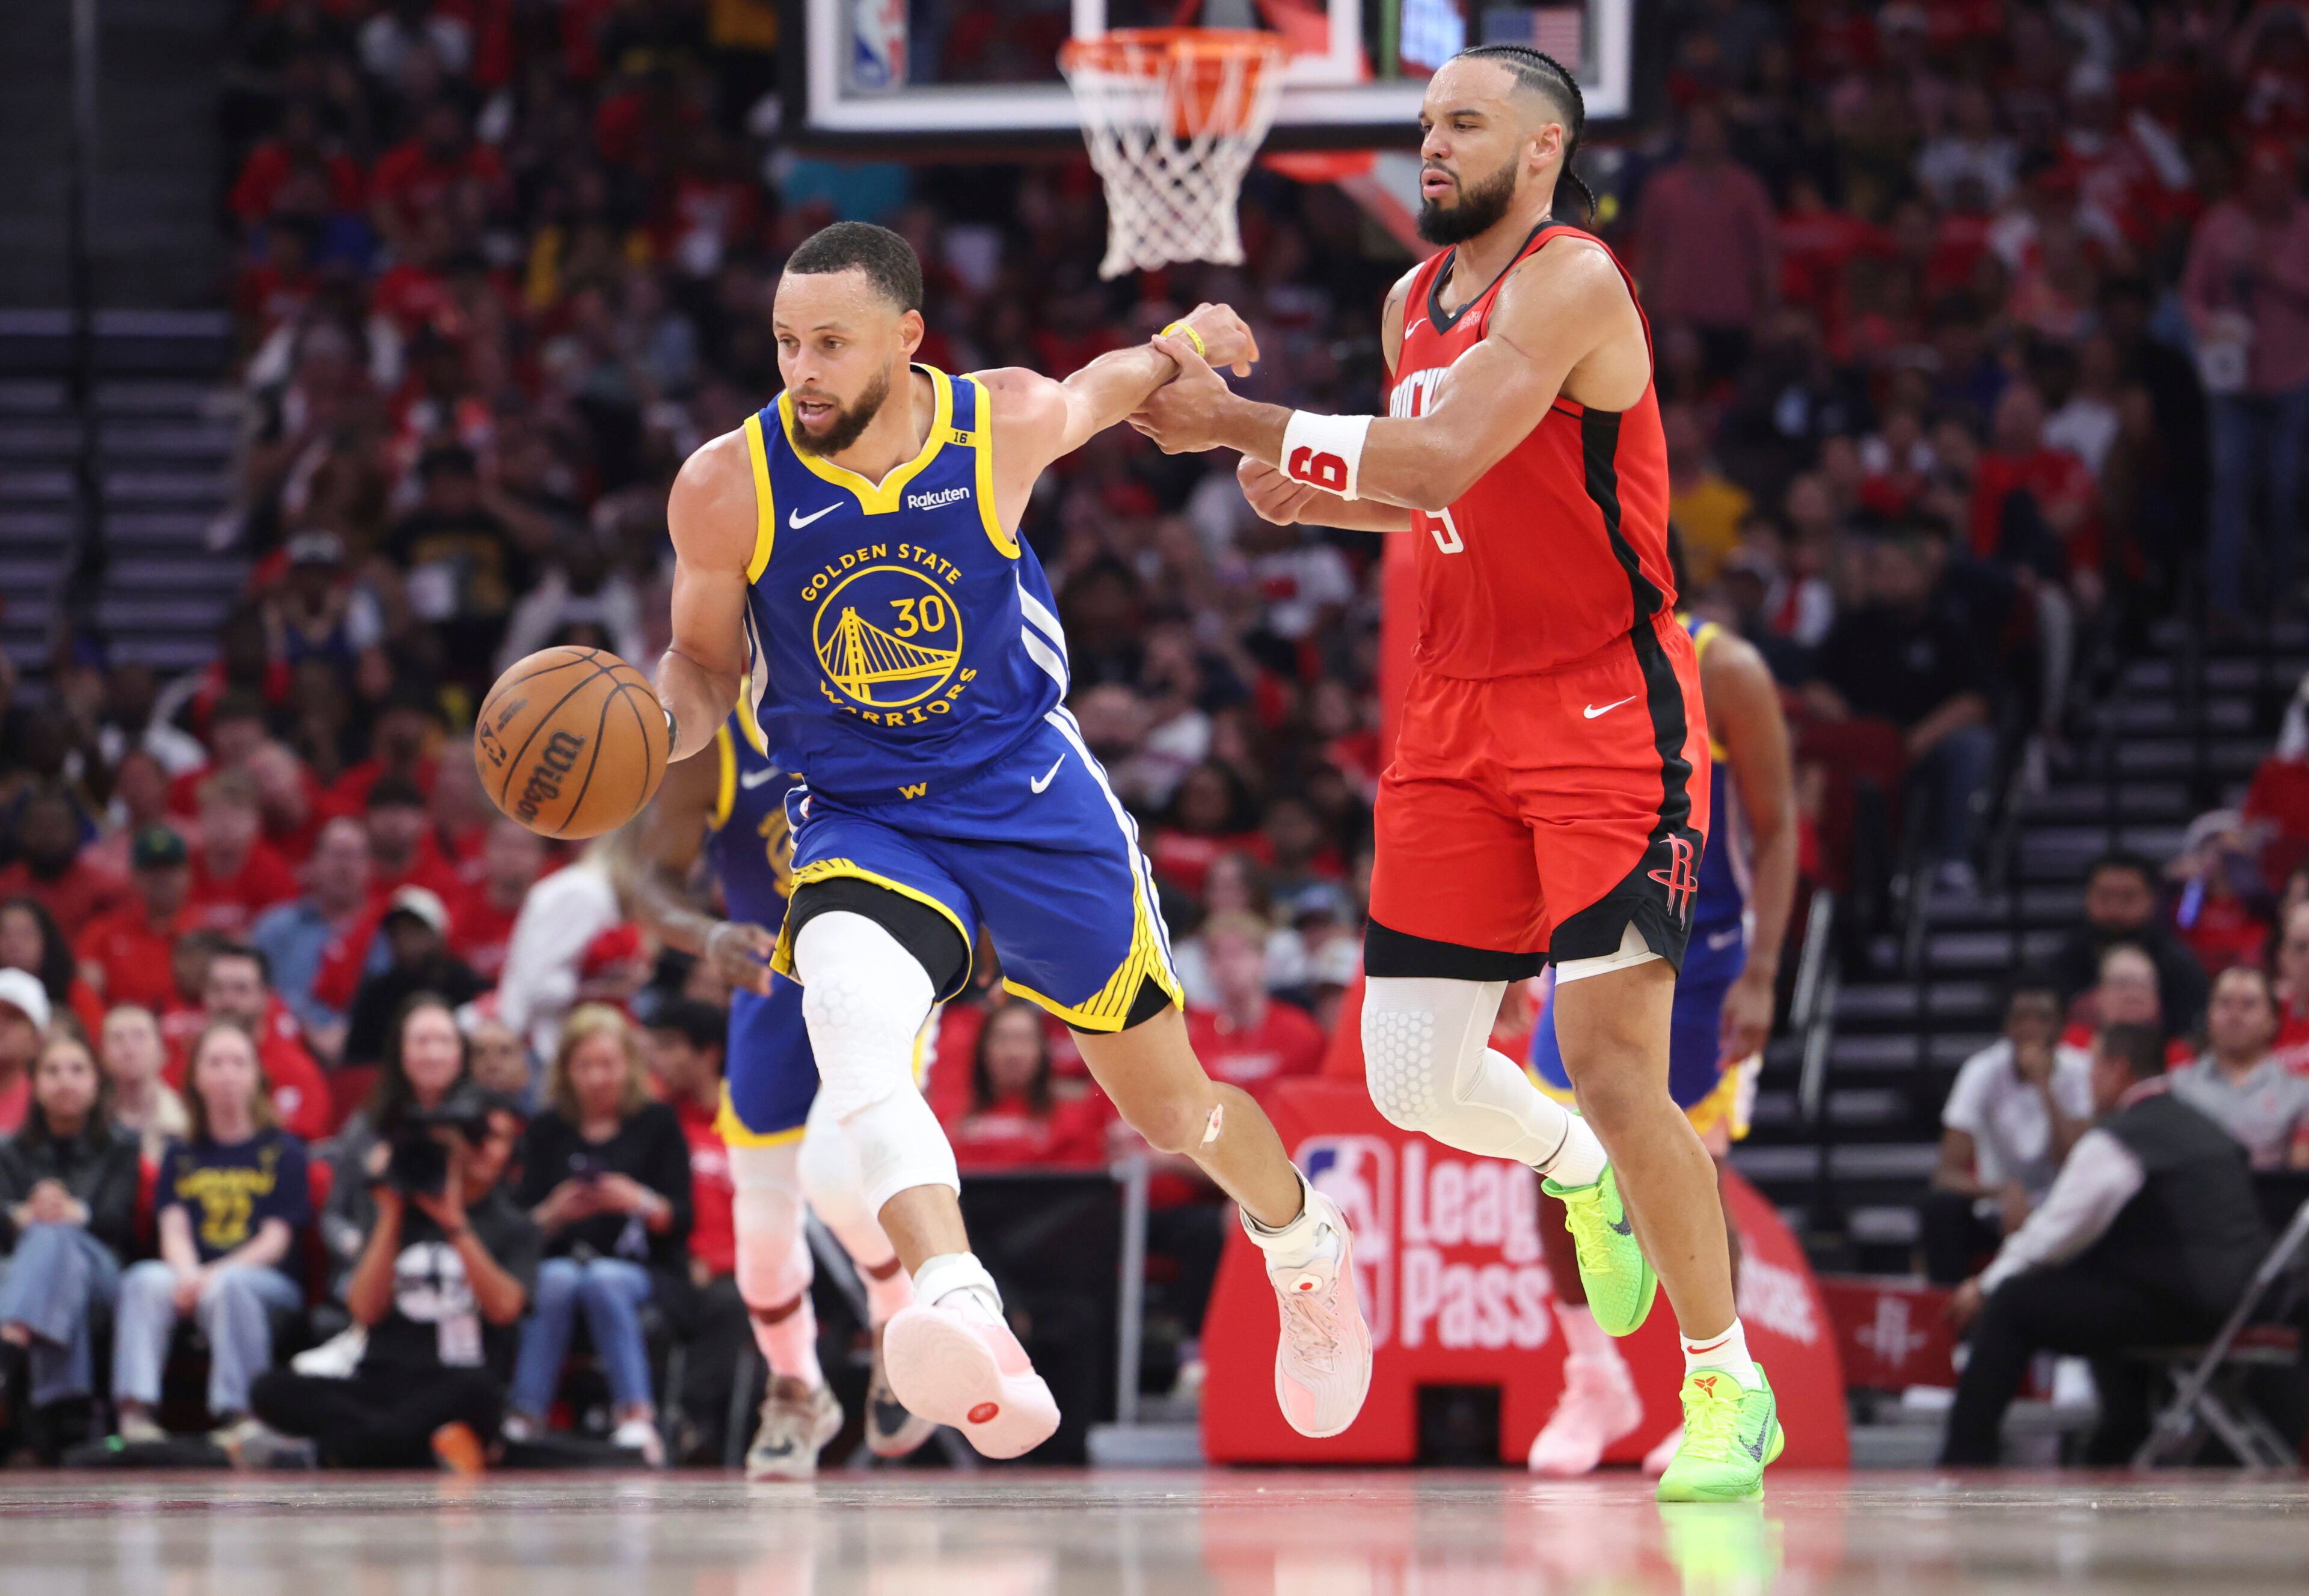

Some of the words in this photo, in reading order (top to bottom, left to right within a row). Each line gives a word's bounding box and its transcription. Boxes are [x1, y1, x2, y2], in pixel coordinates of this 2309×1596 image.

[1390, 367, 1449, 417] ROCK
[954, 432, 968, 444] 16
[907, 487, 970, 510] Rakuten
[801, 543, 887, 601] GOLDEN
[898, 543, 962, 585] STATE
[889, 595, 946, 637] 30
[820, 667, 977, 726] WARRIORS
[898, 782, 927, 800] W
[1400, 1140, 1544, 1264] Leag
[1399, 1248, 1553, 1349] Pass
